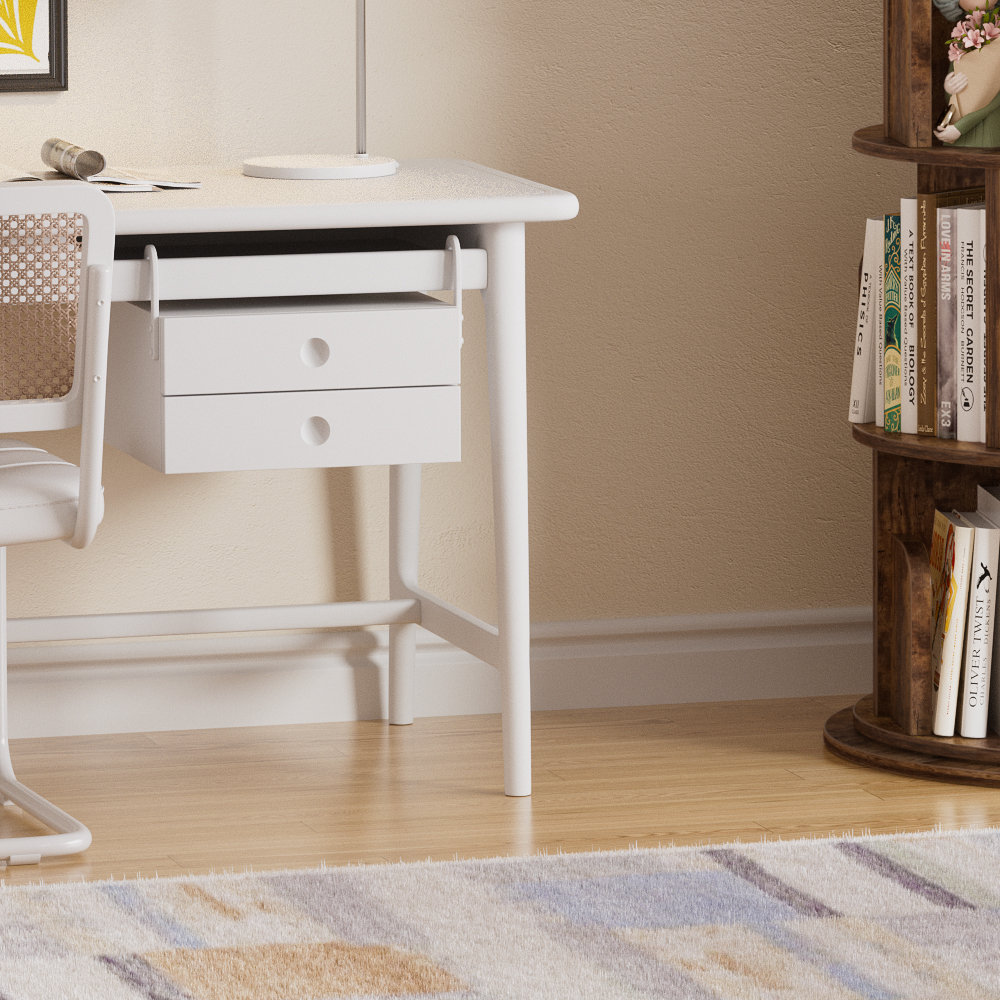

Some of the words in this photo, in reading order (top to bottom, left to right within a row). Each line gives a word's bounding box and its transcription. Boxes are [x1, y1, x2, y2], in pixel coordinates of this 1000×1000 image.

[941, 214, 951, 246] LOVE
[941, 249, 951, 262] IN
[966, 240, 974, 266] THE
[941, 264, 951, 300] ARMS
[966, 269, 974, 320] SECRET
[908, 313, 914, 328] OF
[966, 328, 974, 384] GARDEN
[941, 401, 951, 427] EX3
[973, 597, 984, 645] TWIST
[968, 648, 981, 708] OLIVER
